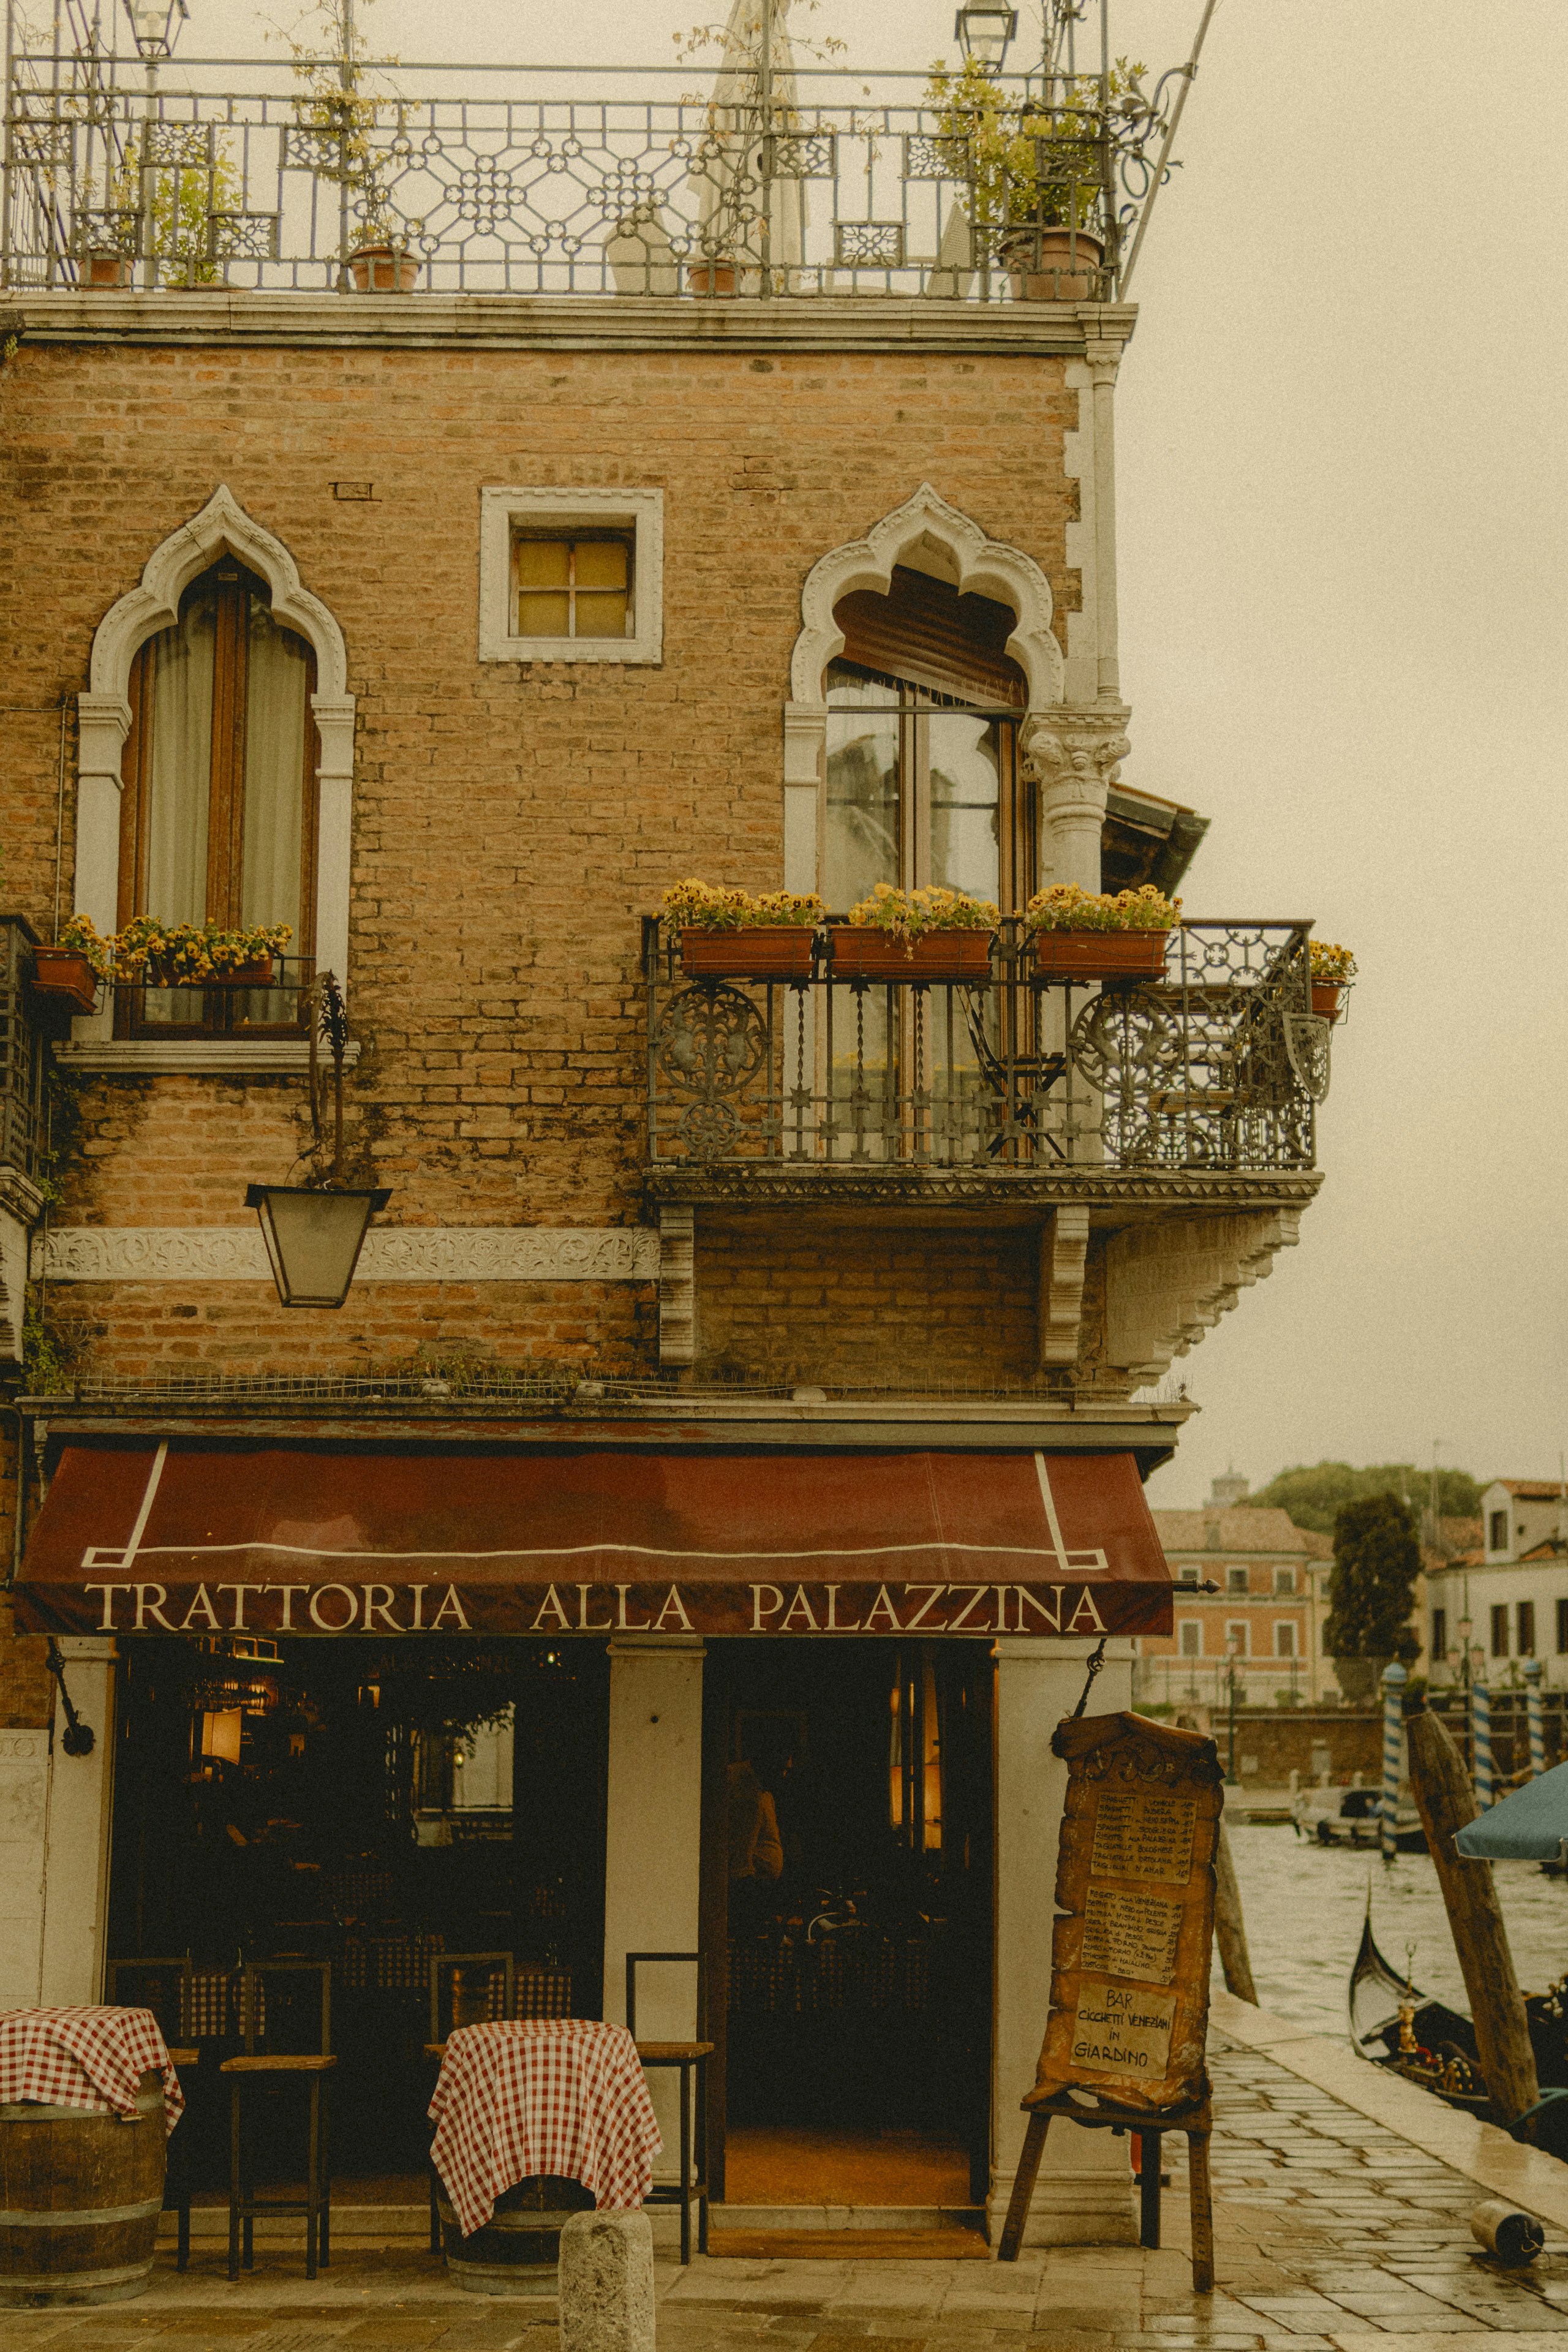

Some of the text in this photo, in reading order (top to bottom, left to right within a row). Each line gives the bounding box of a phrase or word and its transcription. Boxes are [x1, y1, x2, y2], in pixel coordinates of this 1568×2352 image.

[85, 1583, 1109, 1632] TRATTORIA ALLA PALAZZINA
[1099, 1804, 1134, 1814] SPAGHETTI
[1096, 1823, 1132, 1832] SPAGHETTI
[1096, 1831, 1123, 1841] RISOTTO
[1094, 1842, 1133, 1851] TAGLIATELLE
[1138, 1844, 1173, 1854] BOLOGNESE
[1093, 1852, 1134, 1861] TAGLIATELLE
[1090, 1890, 1117, 1900] FEGATO
[1134, 1895, 1169, 1910] VENEZIANA
[1107, 1989, 1133, 2010] BAR
